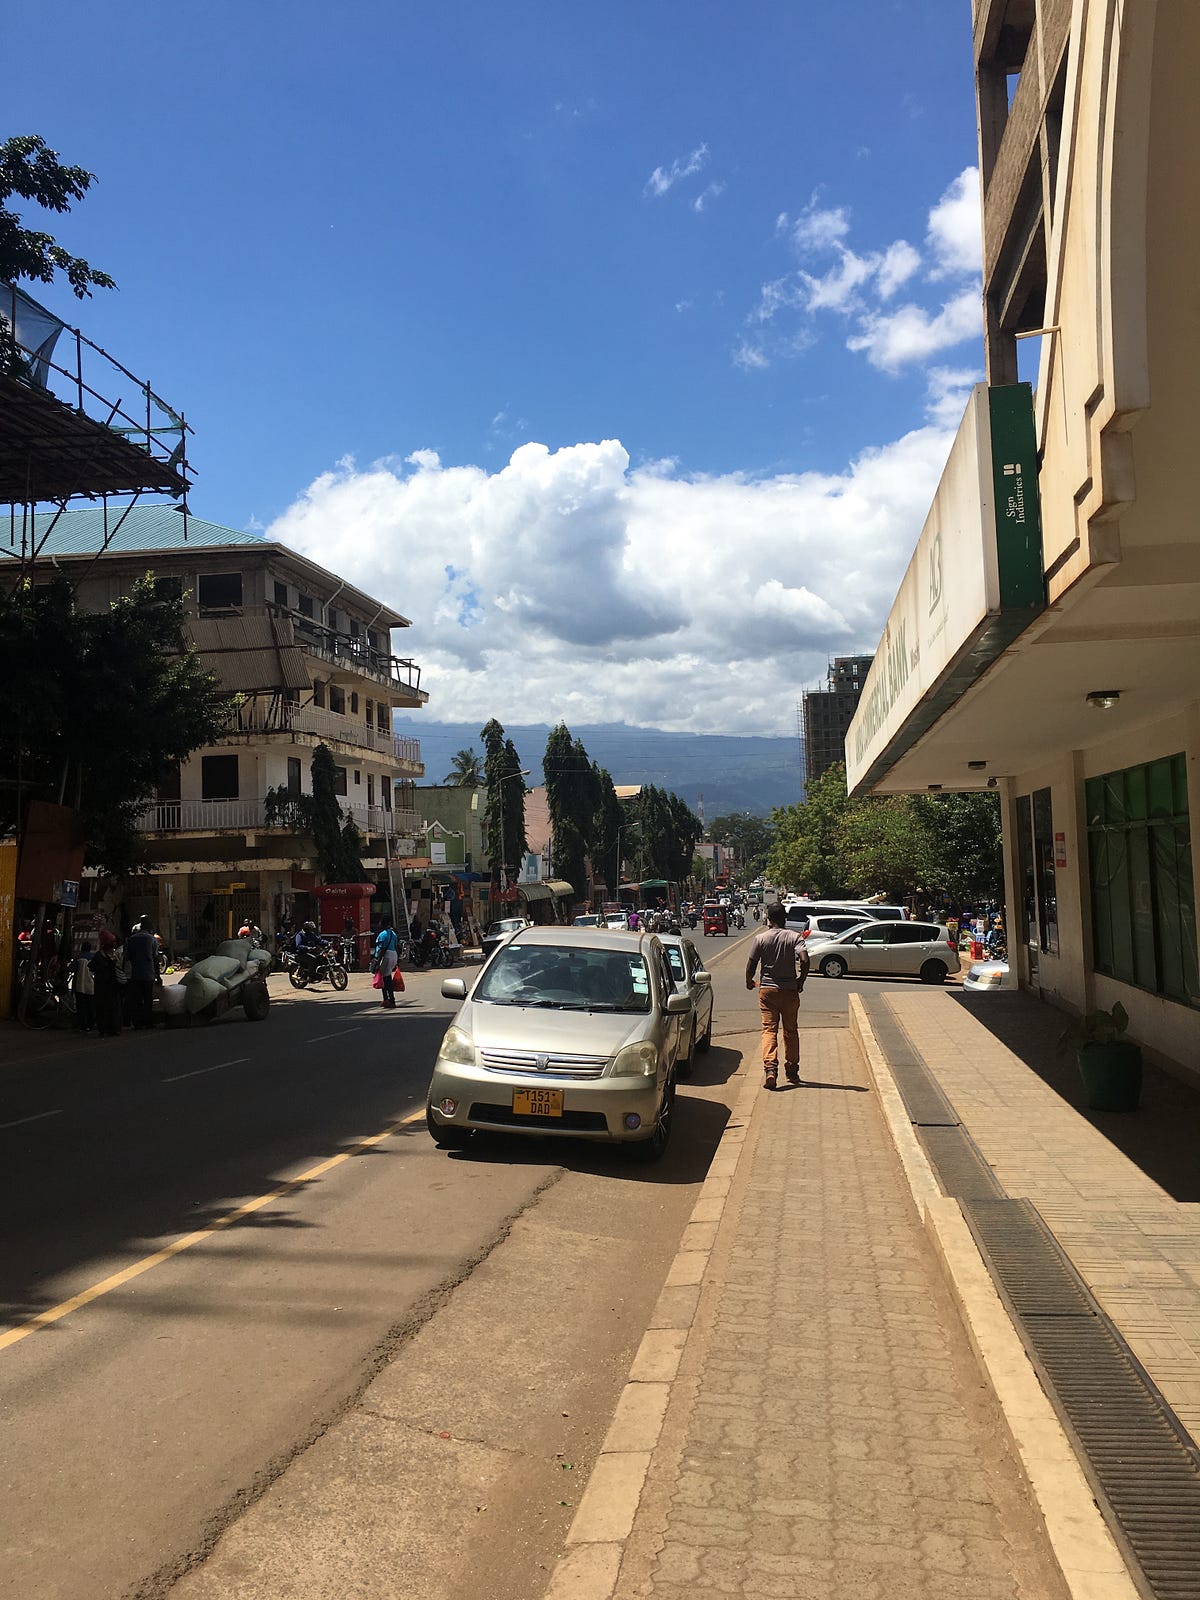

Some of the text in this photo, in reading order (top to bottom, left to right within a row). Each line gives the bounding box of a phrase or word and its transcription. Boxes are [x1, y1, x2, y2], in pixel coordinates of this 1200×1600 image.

[1006, 496, 1018, 517] Sign
[1016, 477, 1025, 524] Industries
[887, 617, 908, 709] BANK
[525, 1090, 550, 1102] T151
[531, 1102, 550, 1115] DAD
